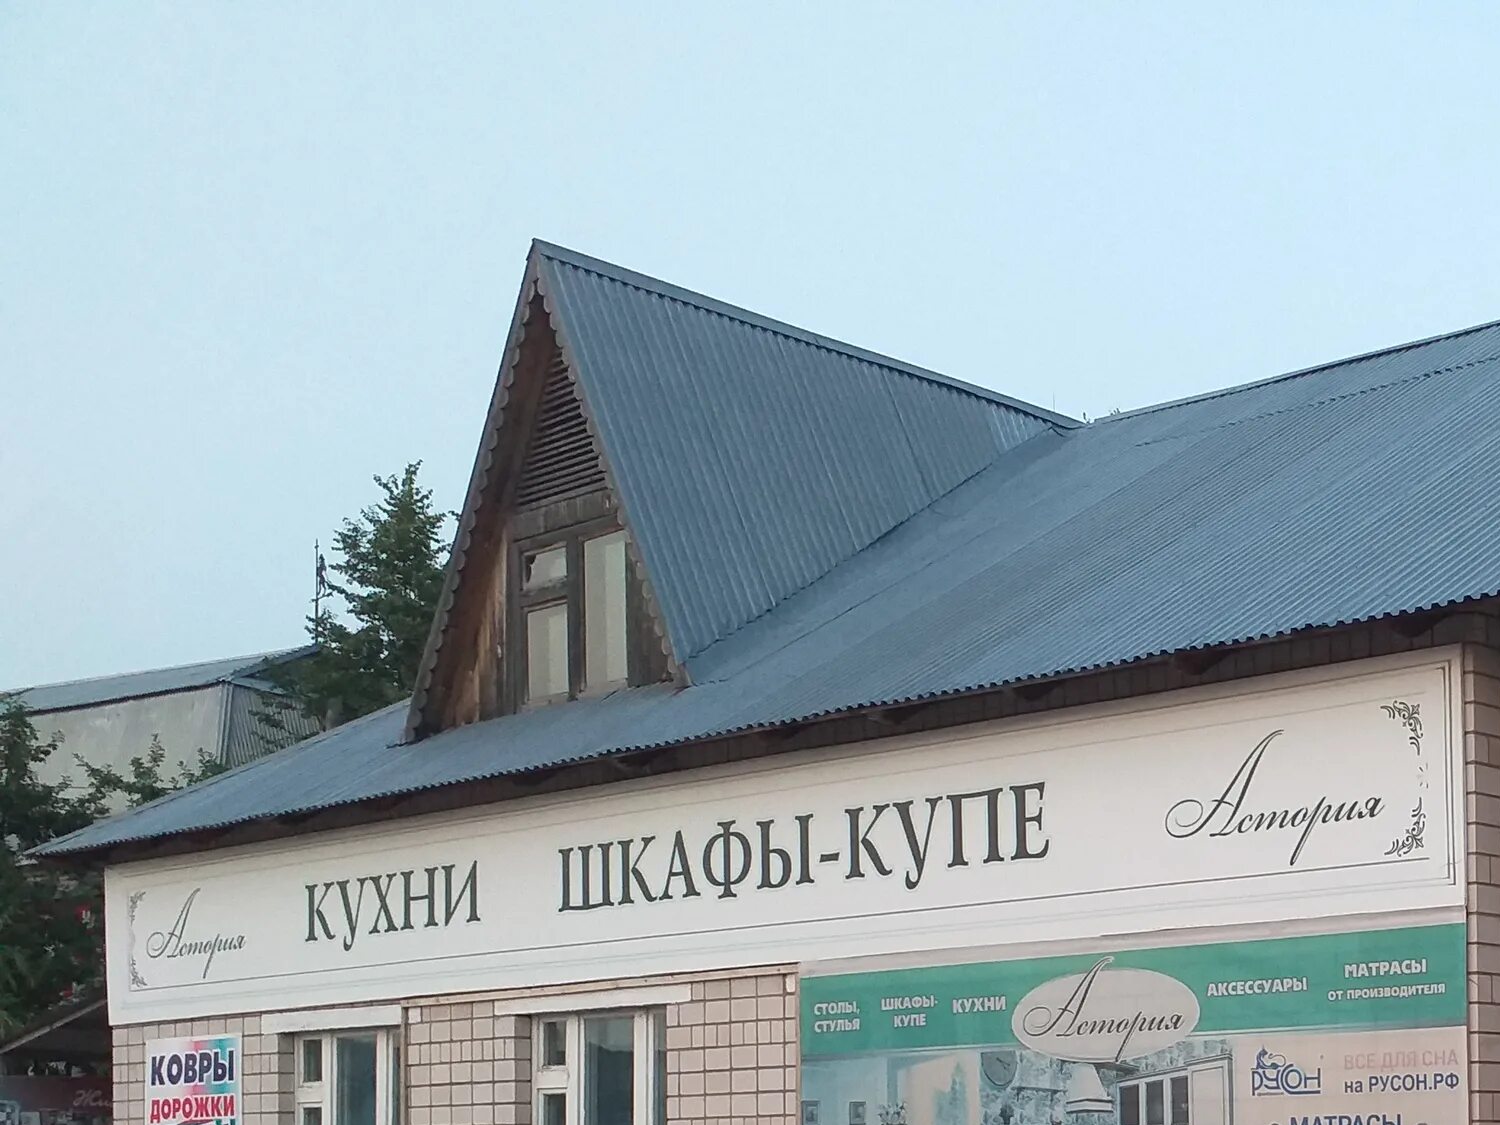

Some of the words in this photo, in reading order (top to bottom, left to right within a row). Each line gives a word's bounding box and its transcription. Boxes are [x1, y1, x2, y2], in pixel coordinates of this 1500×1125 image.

[1165, 729, 1386, 866] Астория
[304, 860, 481, 951] КУХНИ
[557, 781, 1051, 913] ШКАФЫ-КУПЕ
[146, 887, 247, 979] Астория
[1344, 959, 1427, 978] МАТРАСЫ
[1207, 977, 1308, 997] АКСЕССУАРЫ
[1328, 989, 1342, 1001] ОТ
[1347, 983, 1446, 1000] ПРОИЗВОДИТЕЛЯ
[814, 1001, 860, 1016] СТОЛЫ,
[952, 996, 1006, 1014] КУХНИ
[1022, 956, 1185, 1063] Астория
[814, 1018, 860, 1033] СТУЛЬЯ
[894, 1014, 926, 1028] КУПЕ
[151, 1050, 235, 1086] КОВРЫ
[1344, 1054, 1375, 1070] ВСЕ
[1381, 1051, 1417, 1072] ДЛЯ
[1422, 1049, 1459, 1067] СНА
[1344, 1080, 1363, 1093] на
[1368, 1072, 1460, 1093] РУСОН.РФ
[150, 1095, 235, 1123] ДОРОЖКИ
